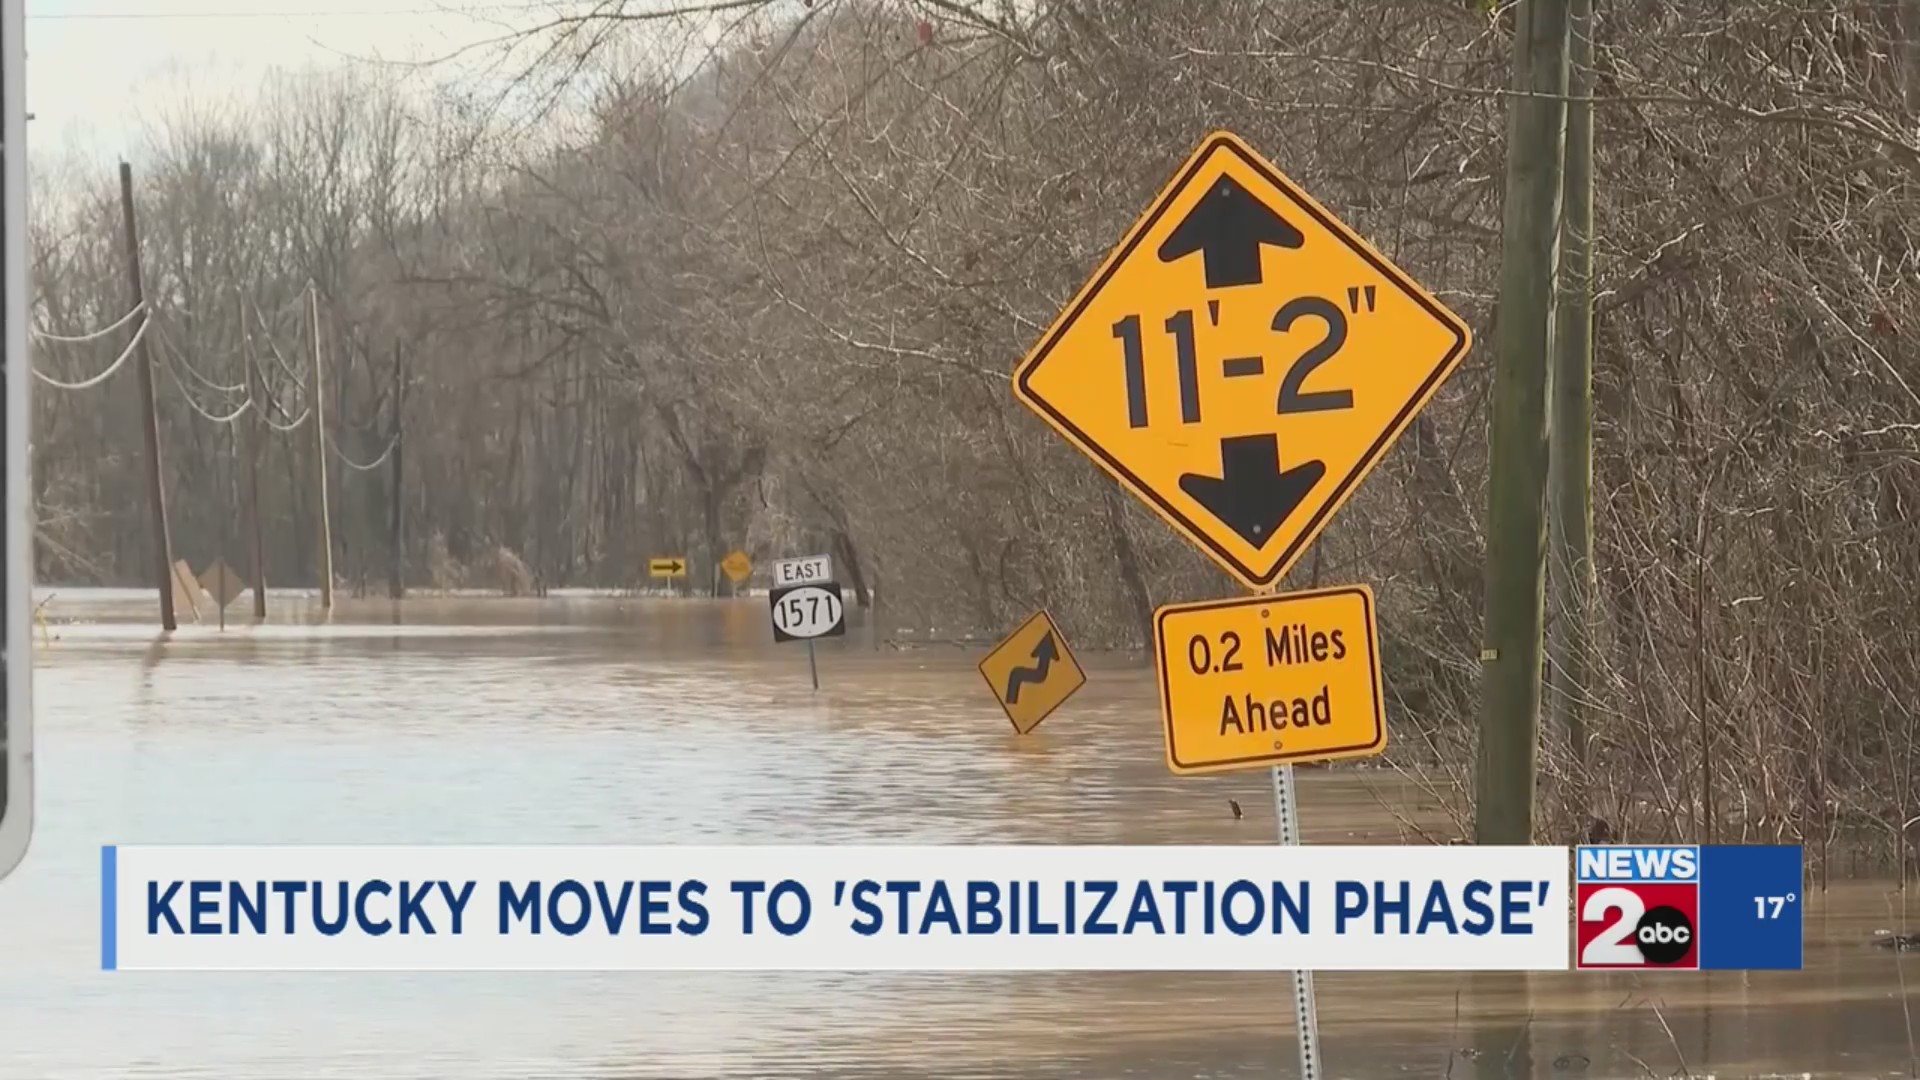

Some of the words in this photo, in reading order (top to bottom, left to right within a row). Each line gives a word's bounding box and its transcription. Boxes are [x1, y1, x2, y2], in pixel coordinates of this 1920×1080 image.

[783, 562, 823, 581] EAST
[779, 595, 835, 629] 1571
[1189, 631, 1243, 674] 0.2
[1265, 625, 1347, 668] Miles
[1220, 685, 1331, 736] Ahead
